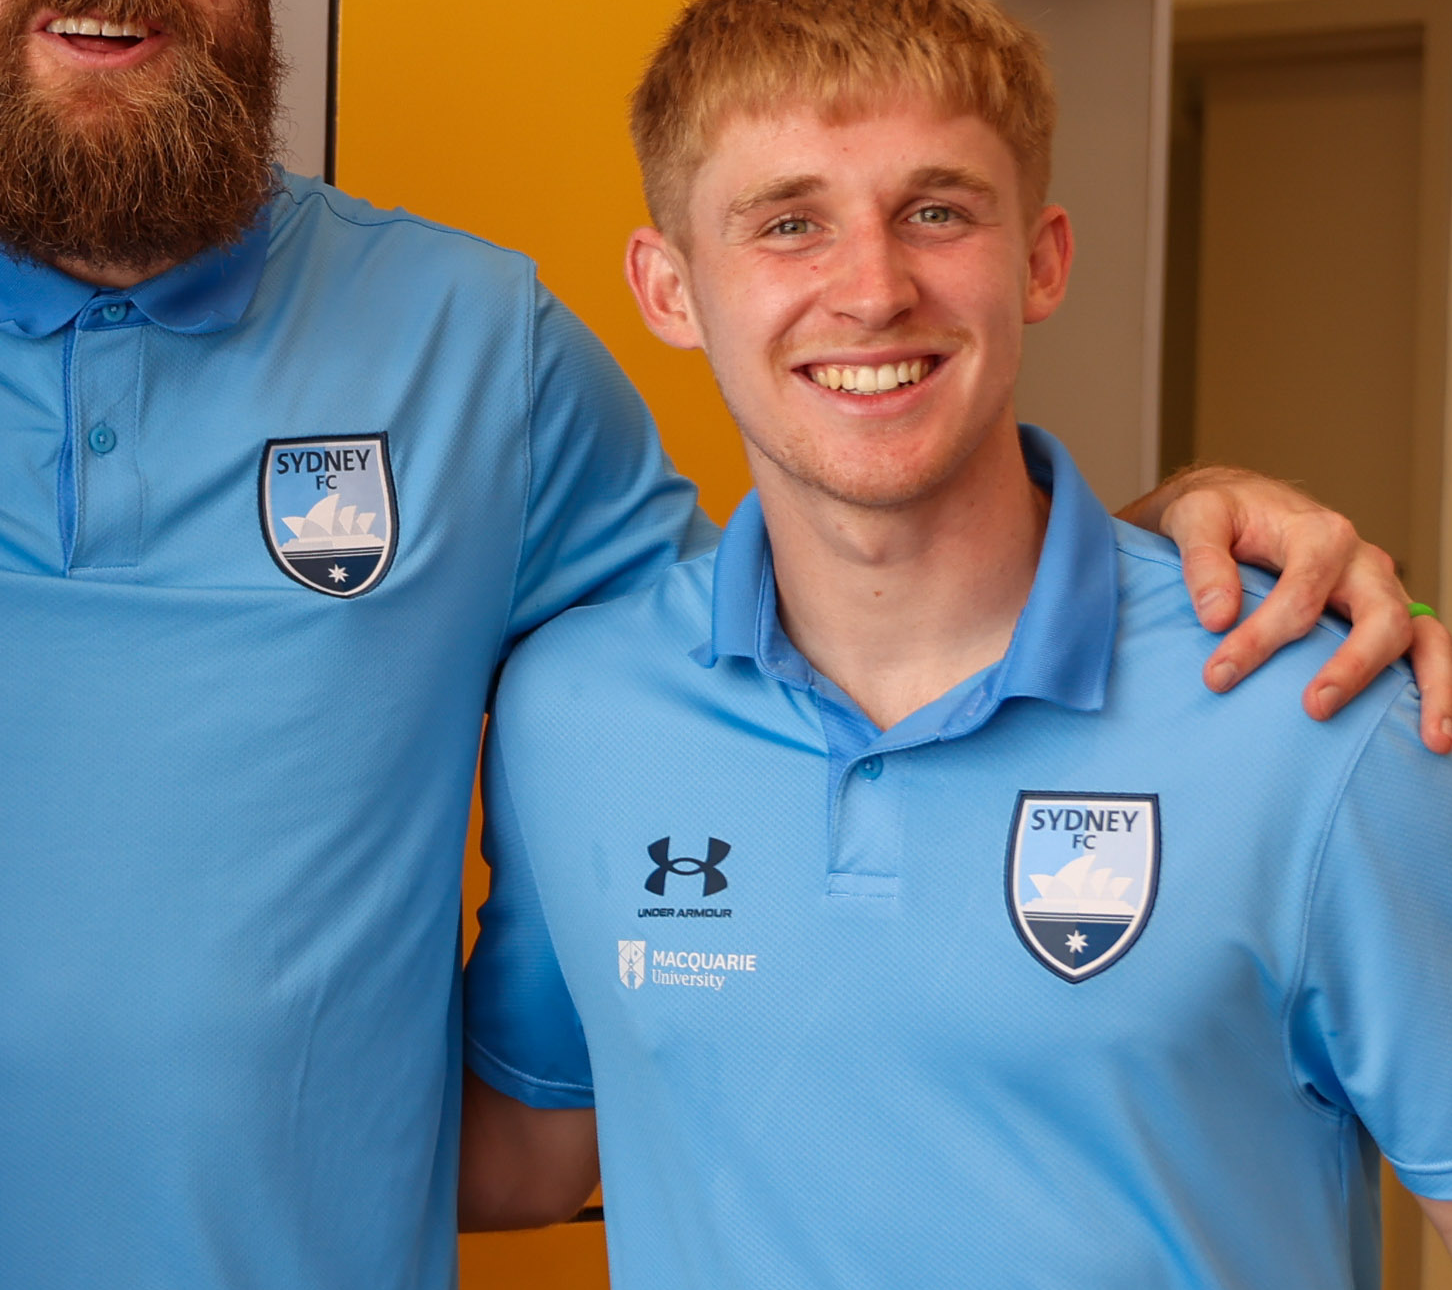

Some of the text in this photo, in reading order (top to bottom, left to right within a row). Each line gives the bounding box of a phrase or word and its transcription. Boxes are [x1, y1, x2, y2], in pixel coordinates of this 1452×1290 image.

[276, 448, 371, 475] SYDNEY
[315, 474, 338, 491] FC
[1030, 808, 1140, 833] SYDNEY
[1071, 833, 1097, 850] FC
[637, 908, 733, 919] UNDER ARMOUR
[652, 950, 758, 972] MACQUARIE
[651, 969, 726, 991] University
